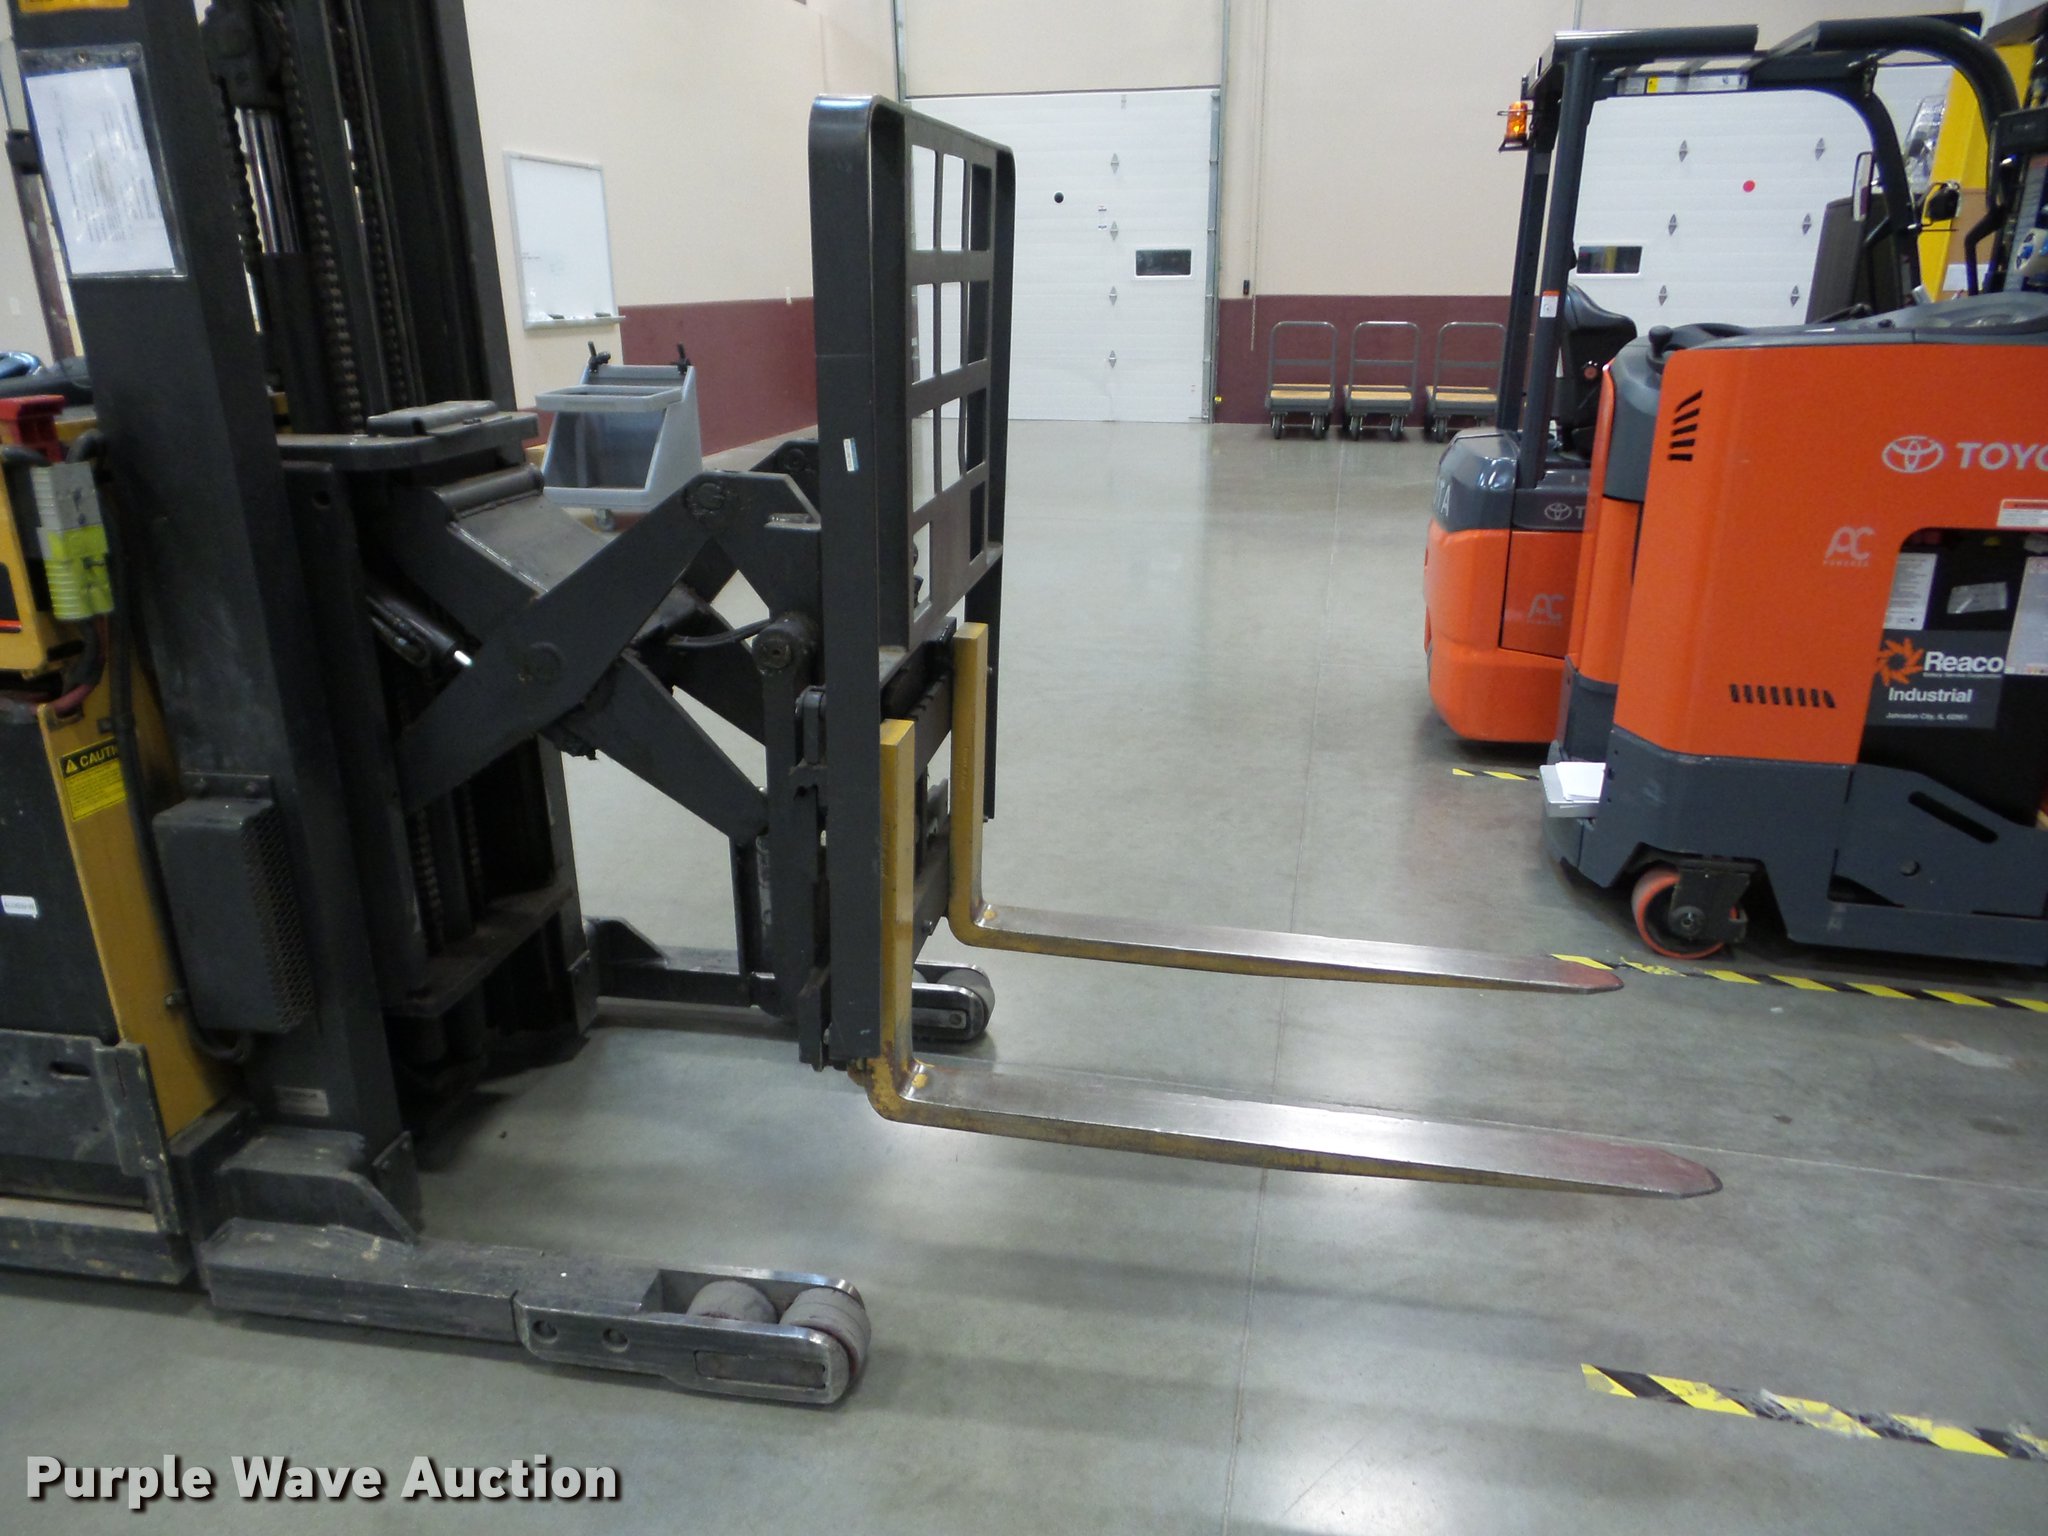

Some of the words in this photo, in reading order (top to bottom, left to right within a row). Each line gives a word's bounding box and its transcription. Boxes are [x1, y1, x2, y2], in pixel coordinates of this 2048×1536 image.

[1923, 650, 2004, 673] Reaco
[1888, 686, 1973, 703] Industrial
[79, 744, 118, 768] CAUTI
